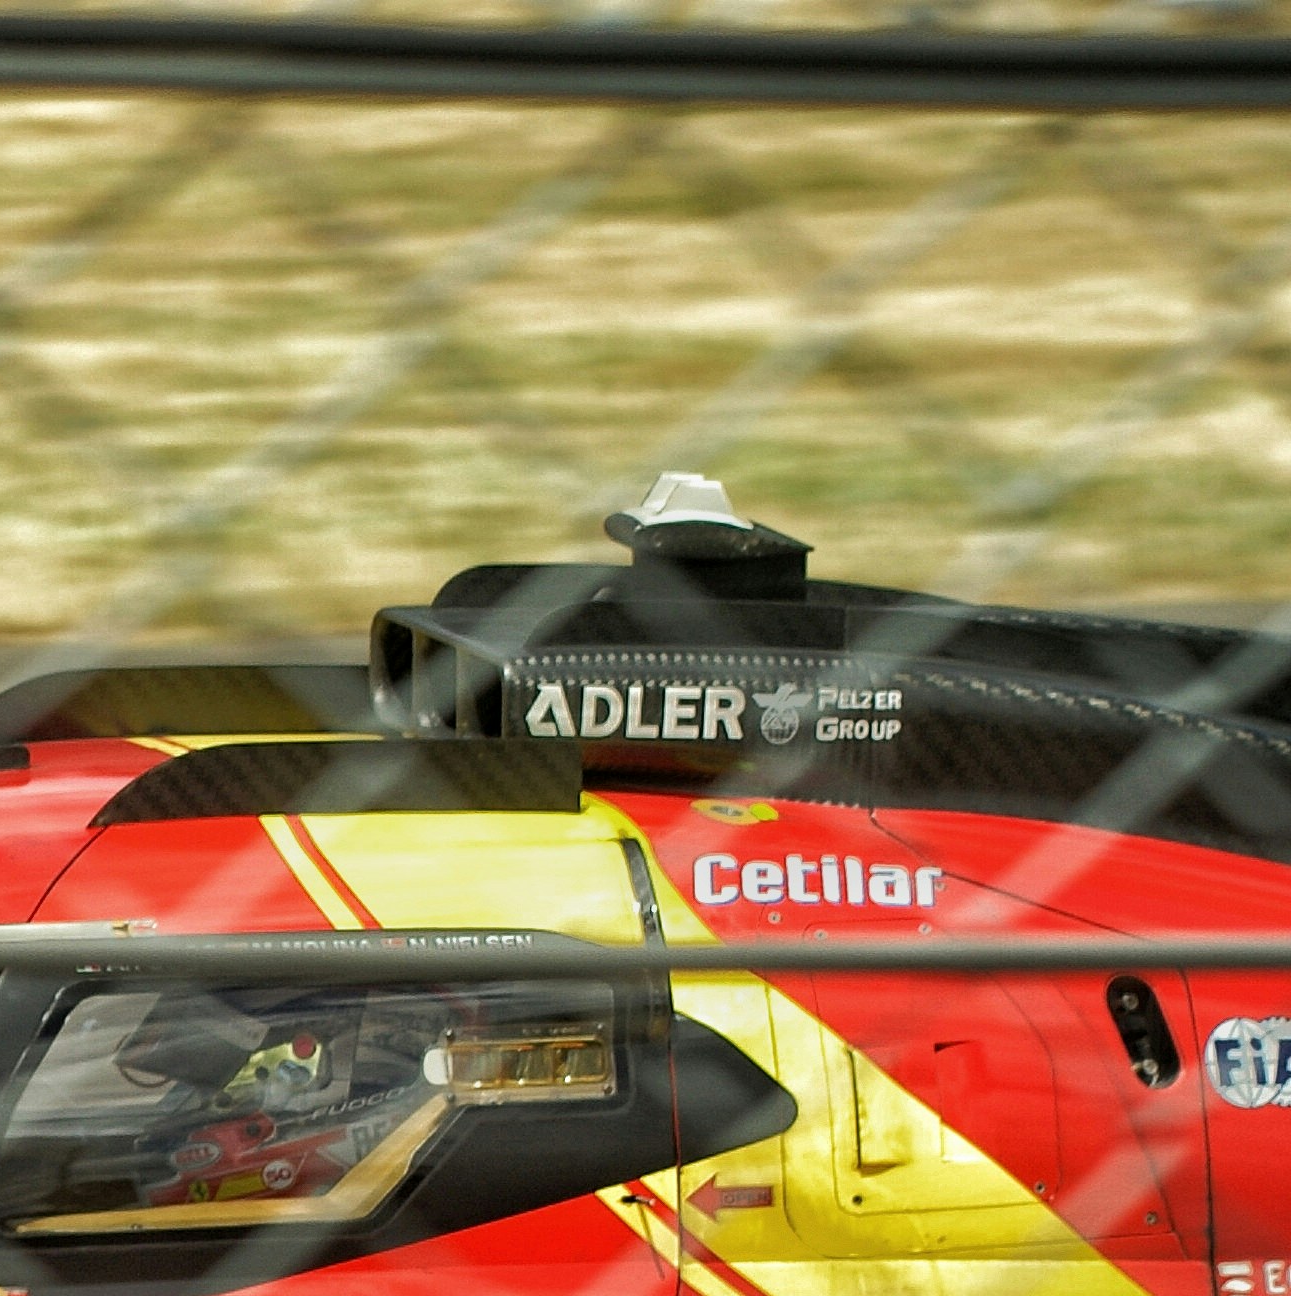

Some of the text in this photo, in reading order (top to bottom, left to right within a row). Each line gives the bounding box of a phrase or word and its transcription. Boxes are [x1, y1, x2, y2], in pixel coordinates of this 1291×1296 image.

[525, 684, 746, 740] ADLER
[818, 688, 902, 712] PELZER
[816, 718, 902, 742] GROUP
[692, 852, 942, 908] Cetilar
